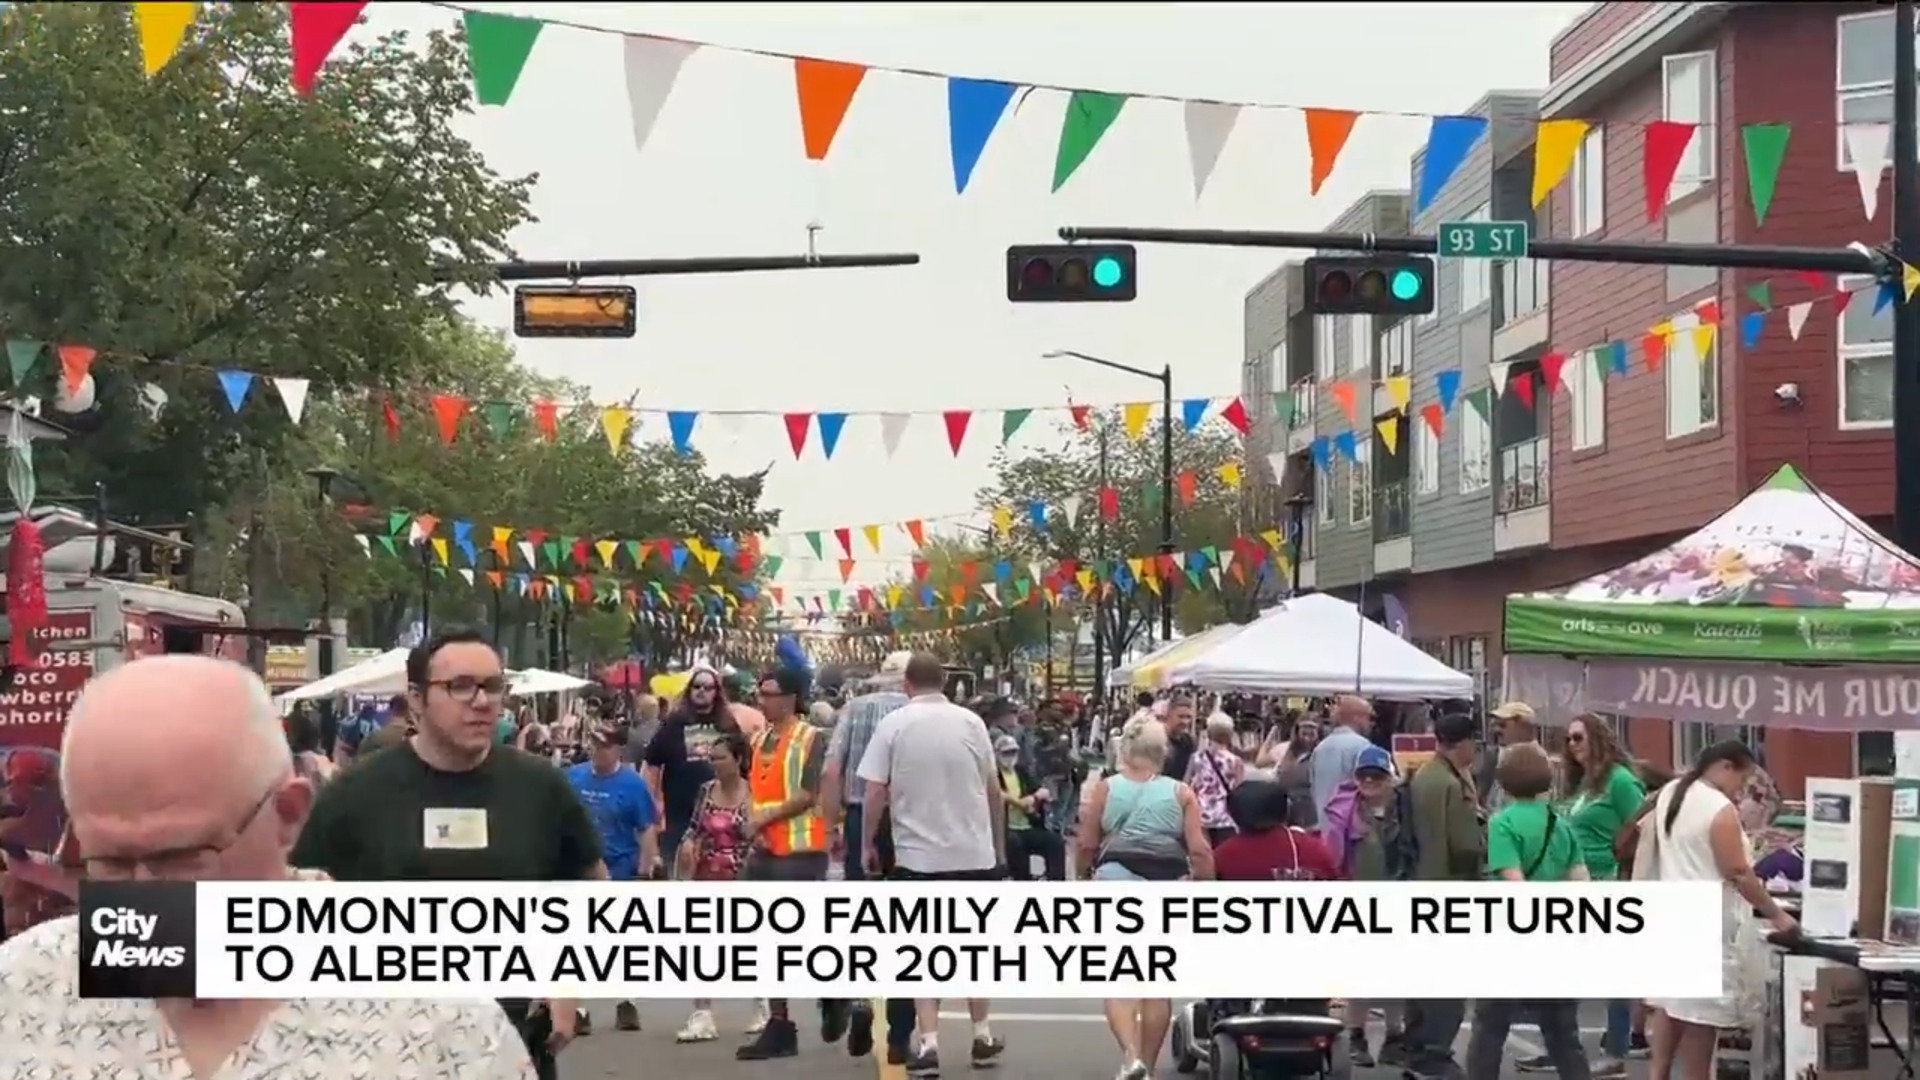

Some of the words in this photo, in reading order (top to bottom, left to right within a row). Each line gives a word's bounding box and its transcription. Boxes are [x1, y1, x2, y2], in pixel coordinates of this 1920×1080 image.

[1449, 228, 1475, 252] 93
[1489, 228, 1515, 252] ST
[1562, 618, 1595, 633] arts
[1627, 621, 1664, 635] ave
[0, 689, 80, 705] wberr
